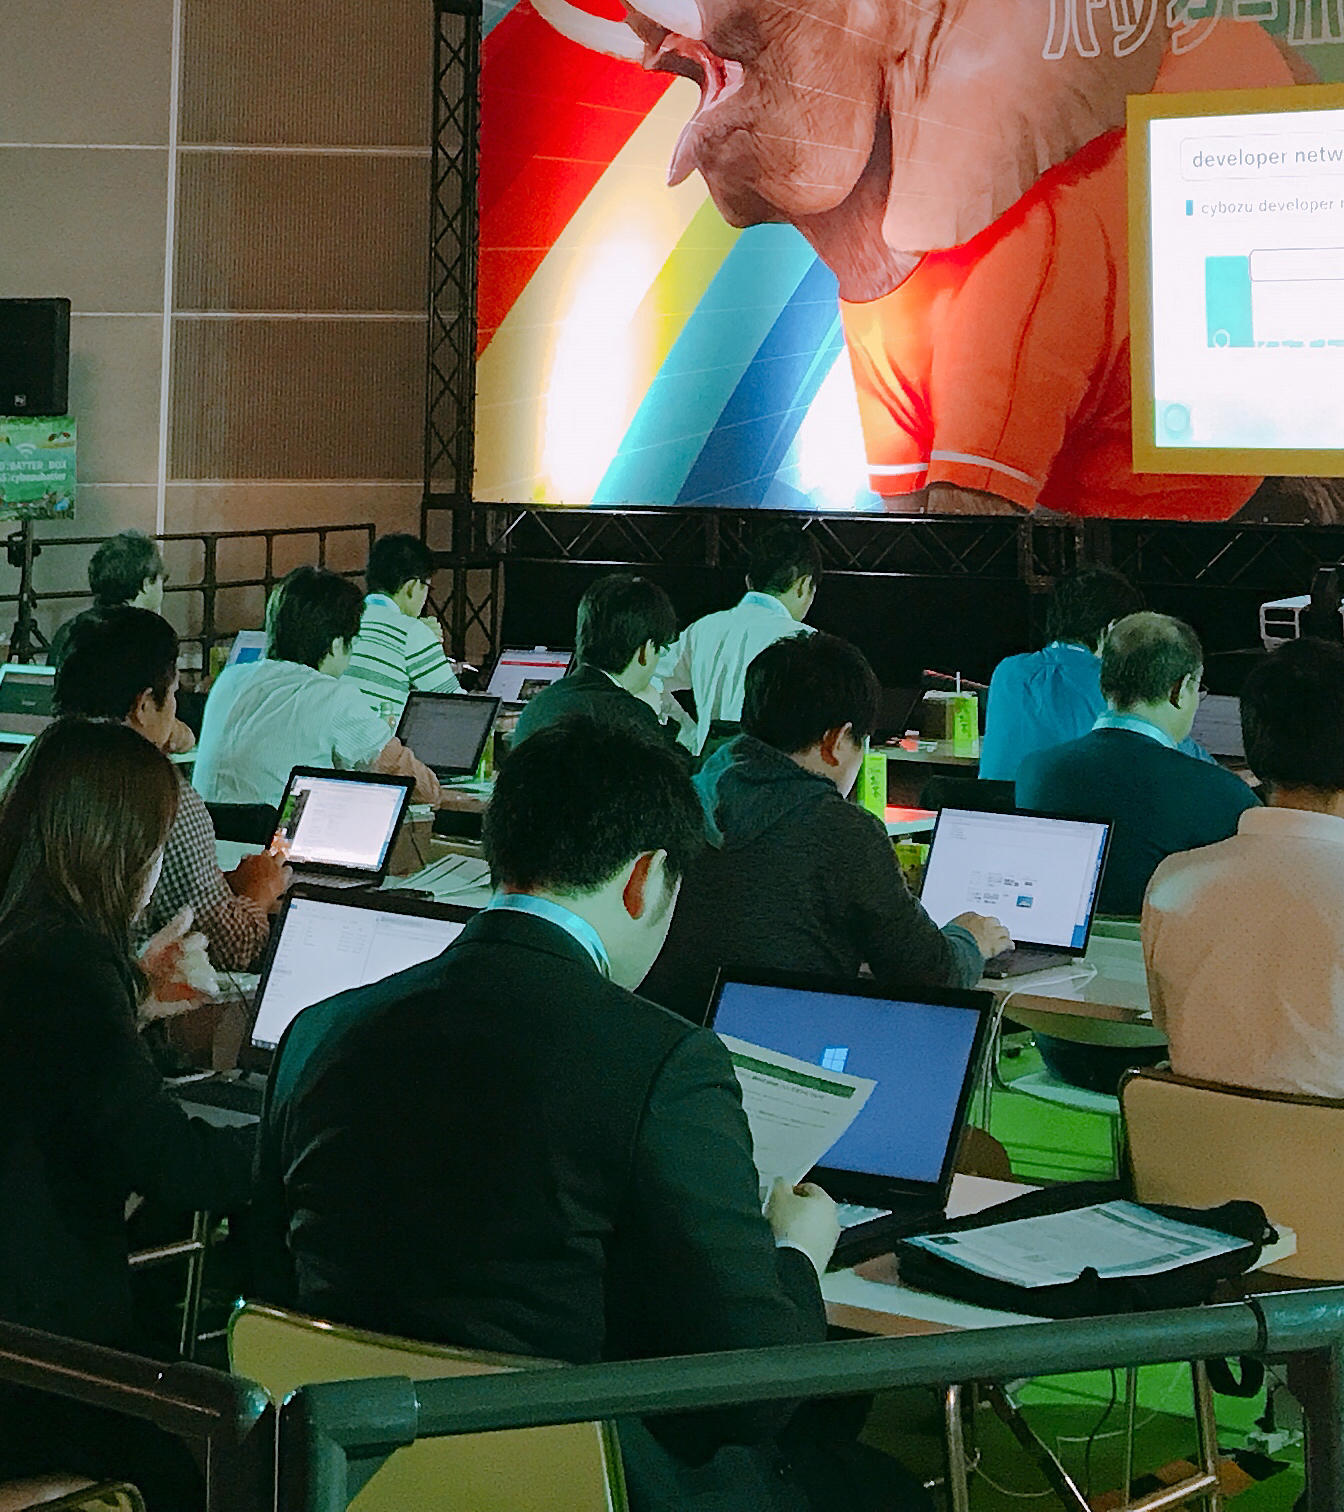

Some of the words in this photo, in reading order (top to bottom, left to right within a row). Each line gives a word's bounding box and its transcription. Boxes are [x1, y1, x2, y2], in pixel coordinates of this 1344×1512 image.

[1192, 148, 1288, 169] developer
[1201, 200, 1254, 218] cybozu
[1258, 197, 1335, 214] developer
